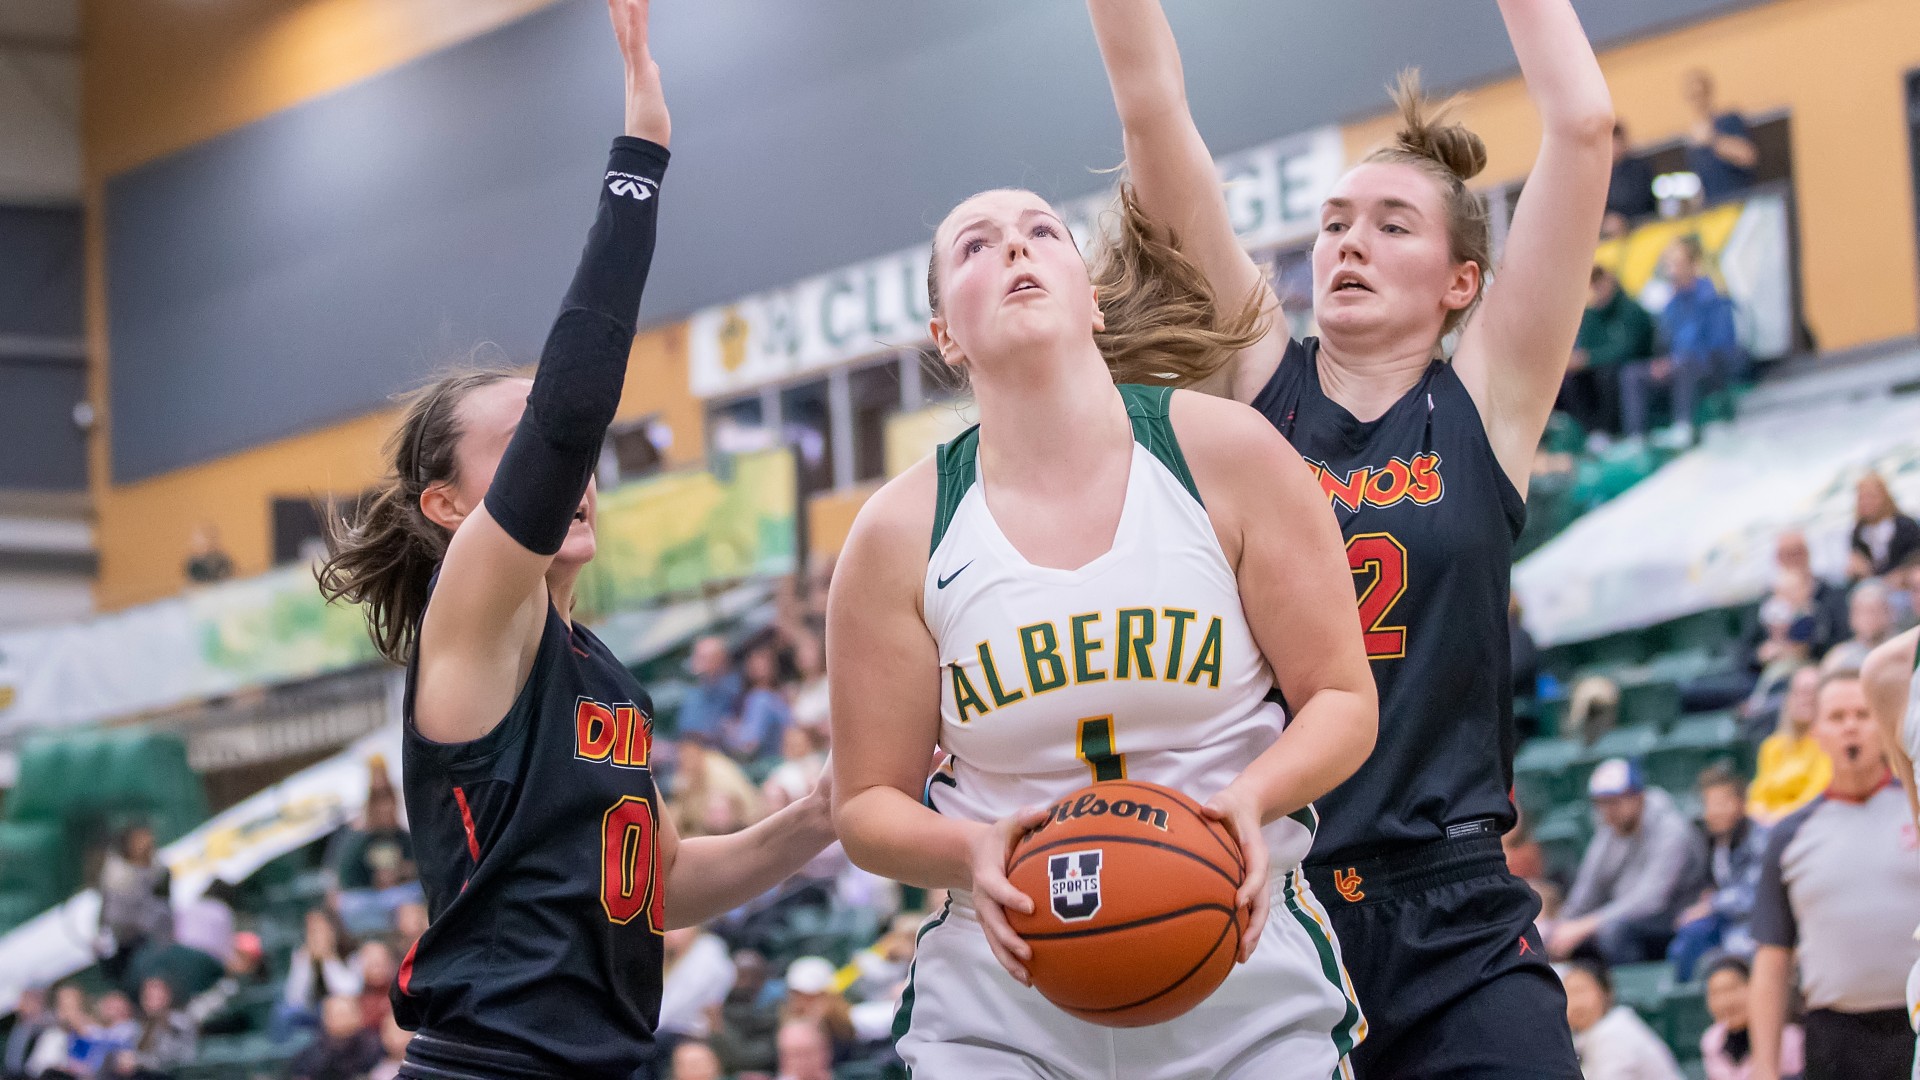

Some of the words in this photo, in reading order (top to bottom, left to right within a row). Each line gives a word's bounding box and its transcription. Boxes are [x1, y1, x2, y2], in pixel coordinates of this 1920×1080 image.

[820, 264, 931, 348] CLU
[1224, 156, 1314, 236] GE
[1303, 451, 1445, 514] NOS
[947, 606, 1223, 724] ALBERTA
[574, 696, 653, 770] DIN
[1075, 713, 1127, 784] 1
[1052, 878, 1098, 895] SPORTS
